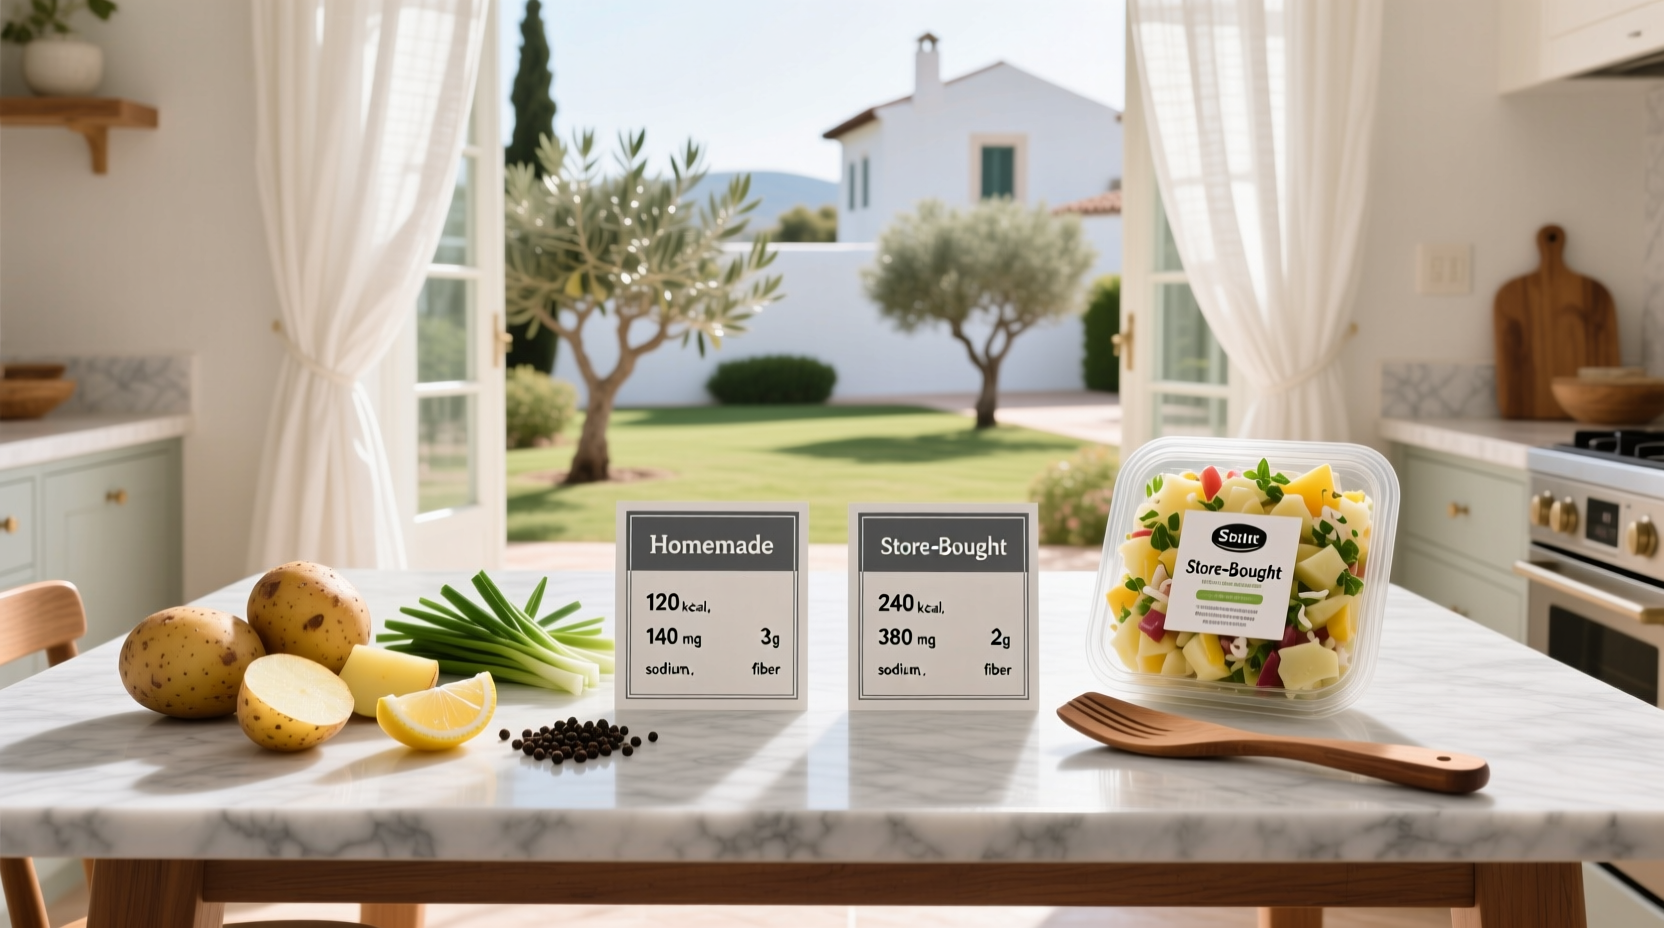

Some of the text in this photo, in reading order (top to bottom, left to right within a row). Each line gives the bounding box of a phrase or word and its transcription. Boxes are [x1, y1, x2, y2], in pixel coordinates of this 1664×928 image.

[649, 534, 774, 555] Homemade
[880, 535, 1008, 561] Store-Bought
[1185, 558, 1283, 583] Store-Bought
[646, 593, 711, 614] 120 kcal,
[878, 593, 914, 612] 240
[646, 627, 702, 648] 140 mg
[760, 627, 780, 649] 3g
[878, 628, 936, 649] 380 mg
[990, 628, 1011, 650] 2g
[751, 661, 781, 676] fiber
[983, 662, 1013, 676] fiber
